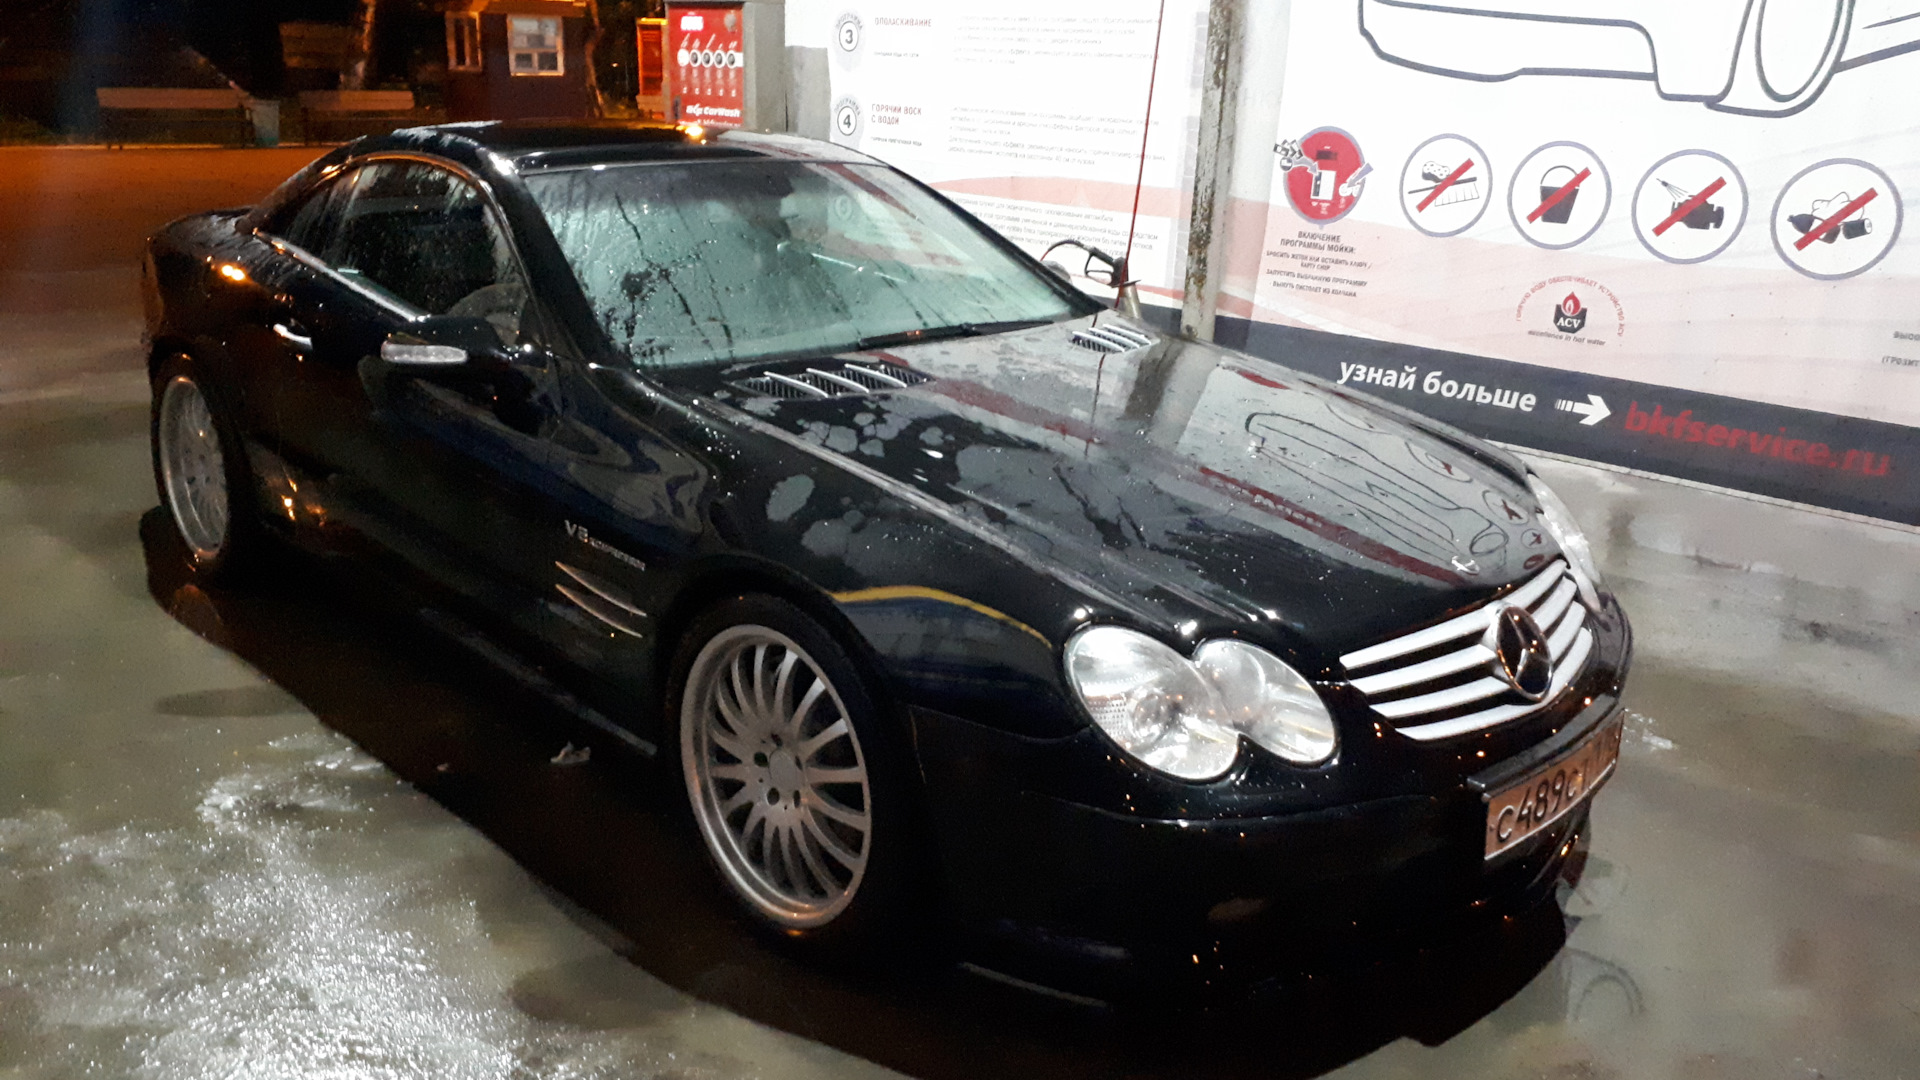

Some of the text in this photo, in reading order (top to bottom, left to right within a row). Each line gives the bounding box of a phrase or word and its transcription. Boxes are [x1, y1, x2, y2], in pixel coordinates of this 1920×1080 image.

[874, 17, 932, 28] ОПОЛАСКИВАНИЕ
[845, 29, 854, 44] 3
[843, 114, 852, 129] 4
[1280, 238, 1325, 251] ПРОГРАММЫ
[1298, 231, 1341, 243] ВКЛЮЧЕНИЕ
[1556, 317, 1581, 329] ACV
[1527, 330, 1563, 340] excellence
[1586, 338, 1606, 346] water
[1336, 361, 1537, 412] узнай больше
[1624, 400, 1891, 476] bkfservice.ru
